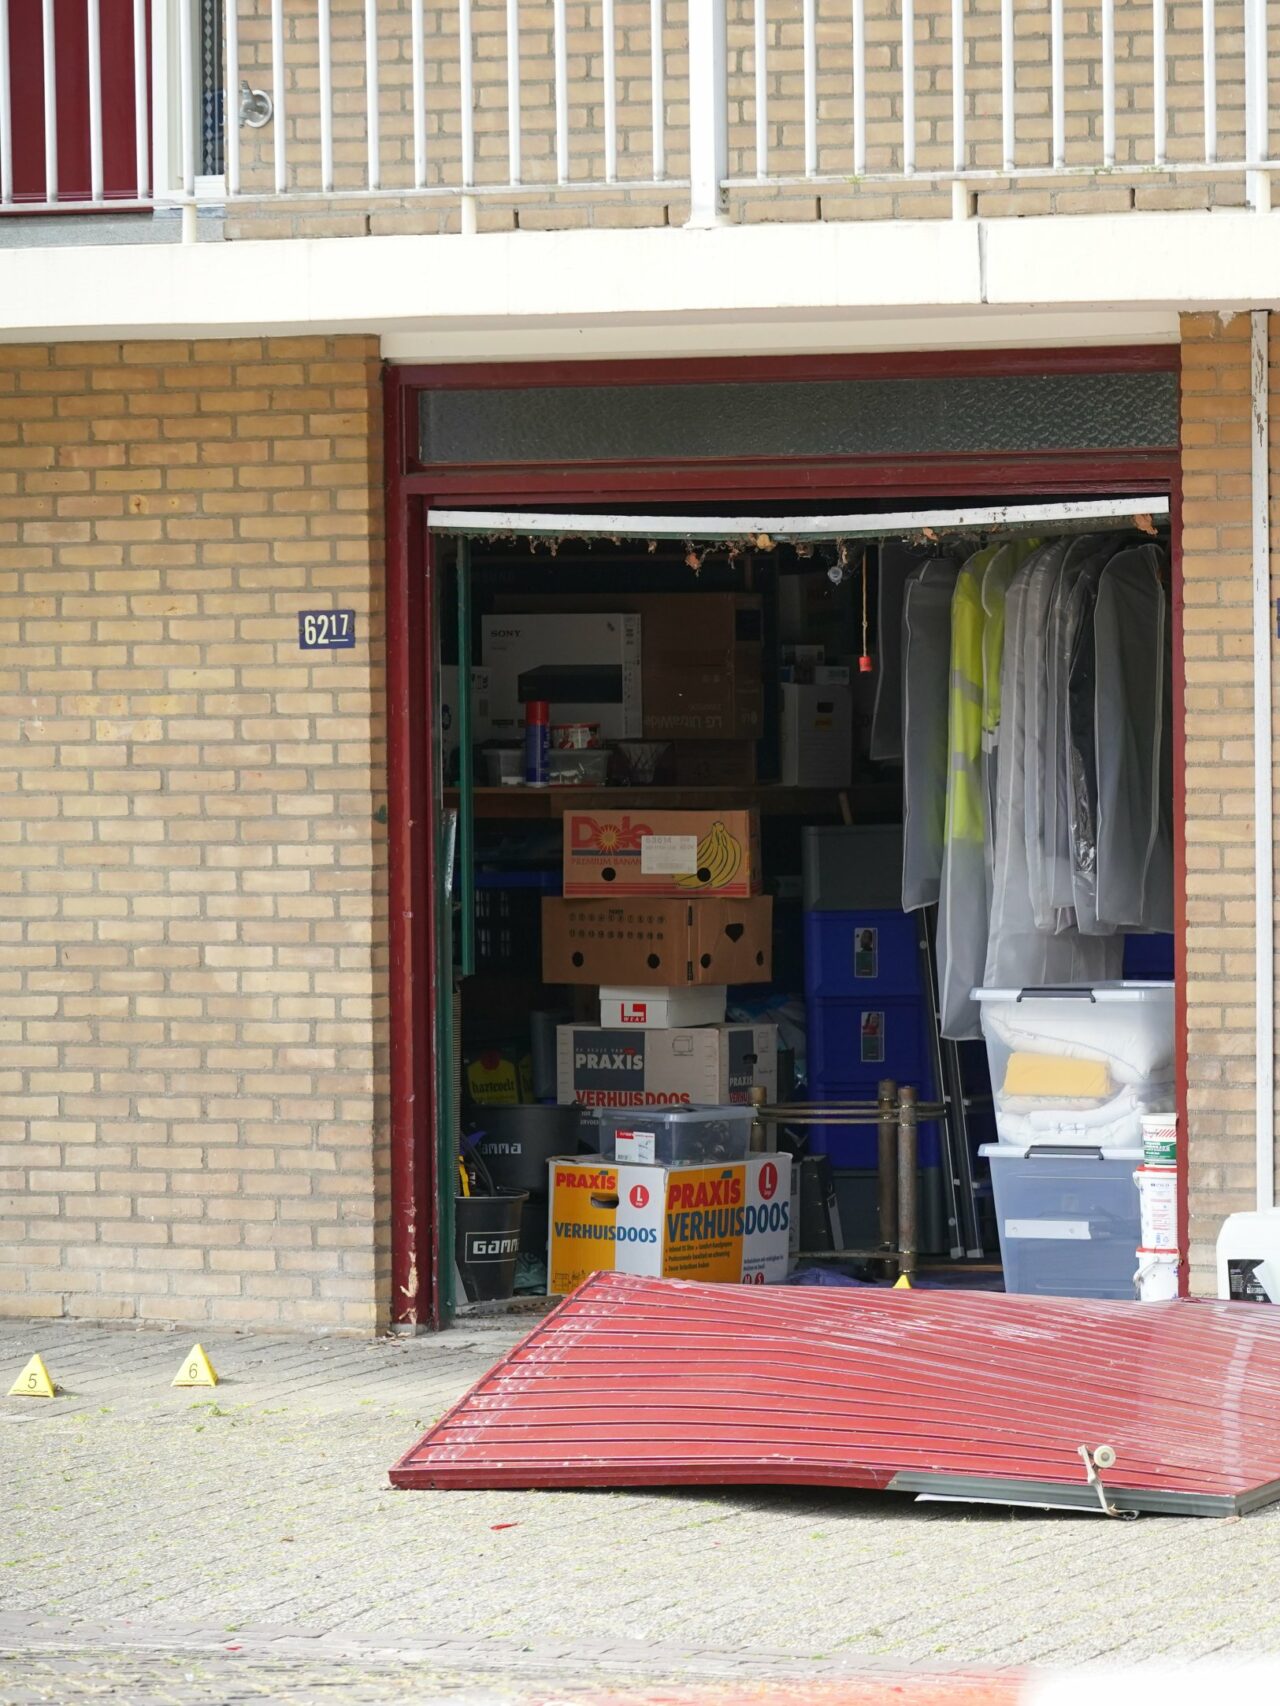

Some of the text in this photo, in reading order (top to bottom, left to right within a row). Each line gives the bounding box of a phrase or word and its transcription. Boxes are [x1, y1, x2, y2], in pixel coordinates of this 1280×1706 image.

[304, 614, 349, 645] 6217
[490, 629, 521, 638] SONY
[571, 815, 654, 852] Dole
[575, 1053, 644, 1071] PRAXIS
[729, 1076, 753, 1087] PRAXIS
[555, 1172, 616, 1190] PRAXIS
[667, 1178, 741, 1211] PRAXIS
[667, 1201, 790, 1243] VERHUISDOOS
[554, 1222, 657, 1243] VERHUISDOOS
[188, 1363, 199, 1379] 6
[27, 1373, 38, 1390] 5
